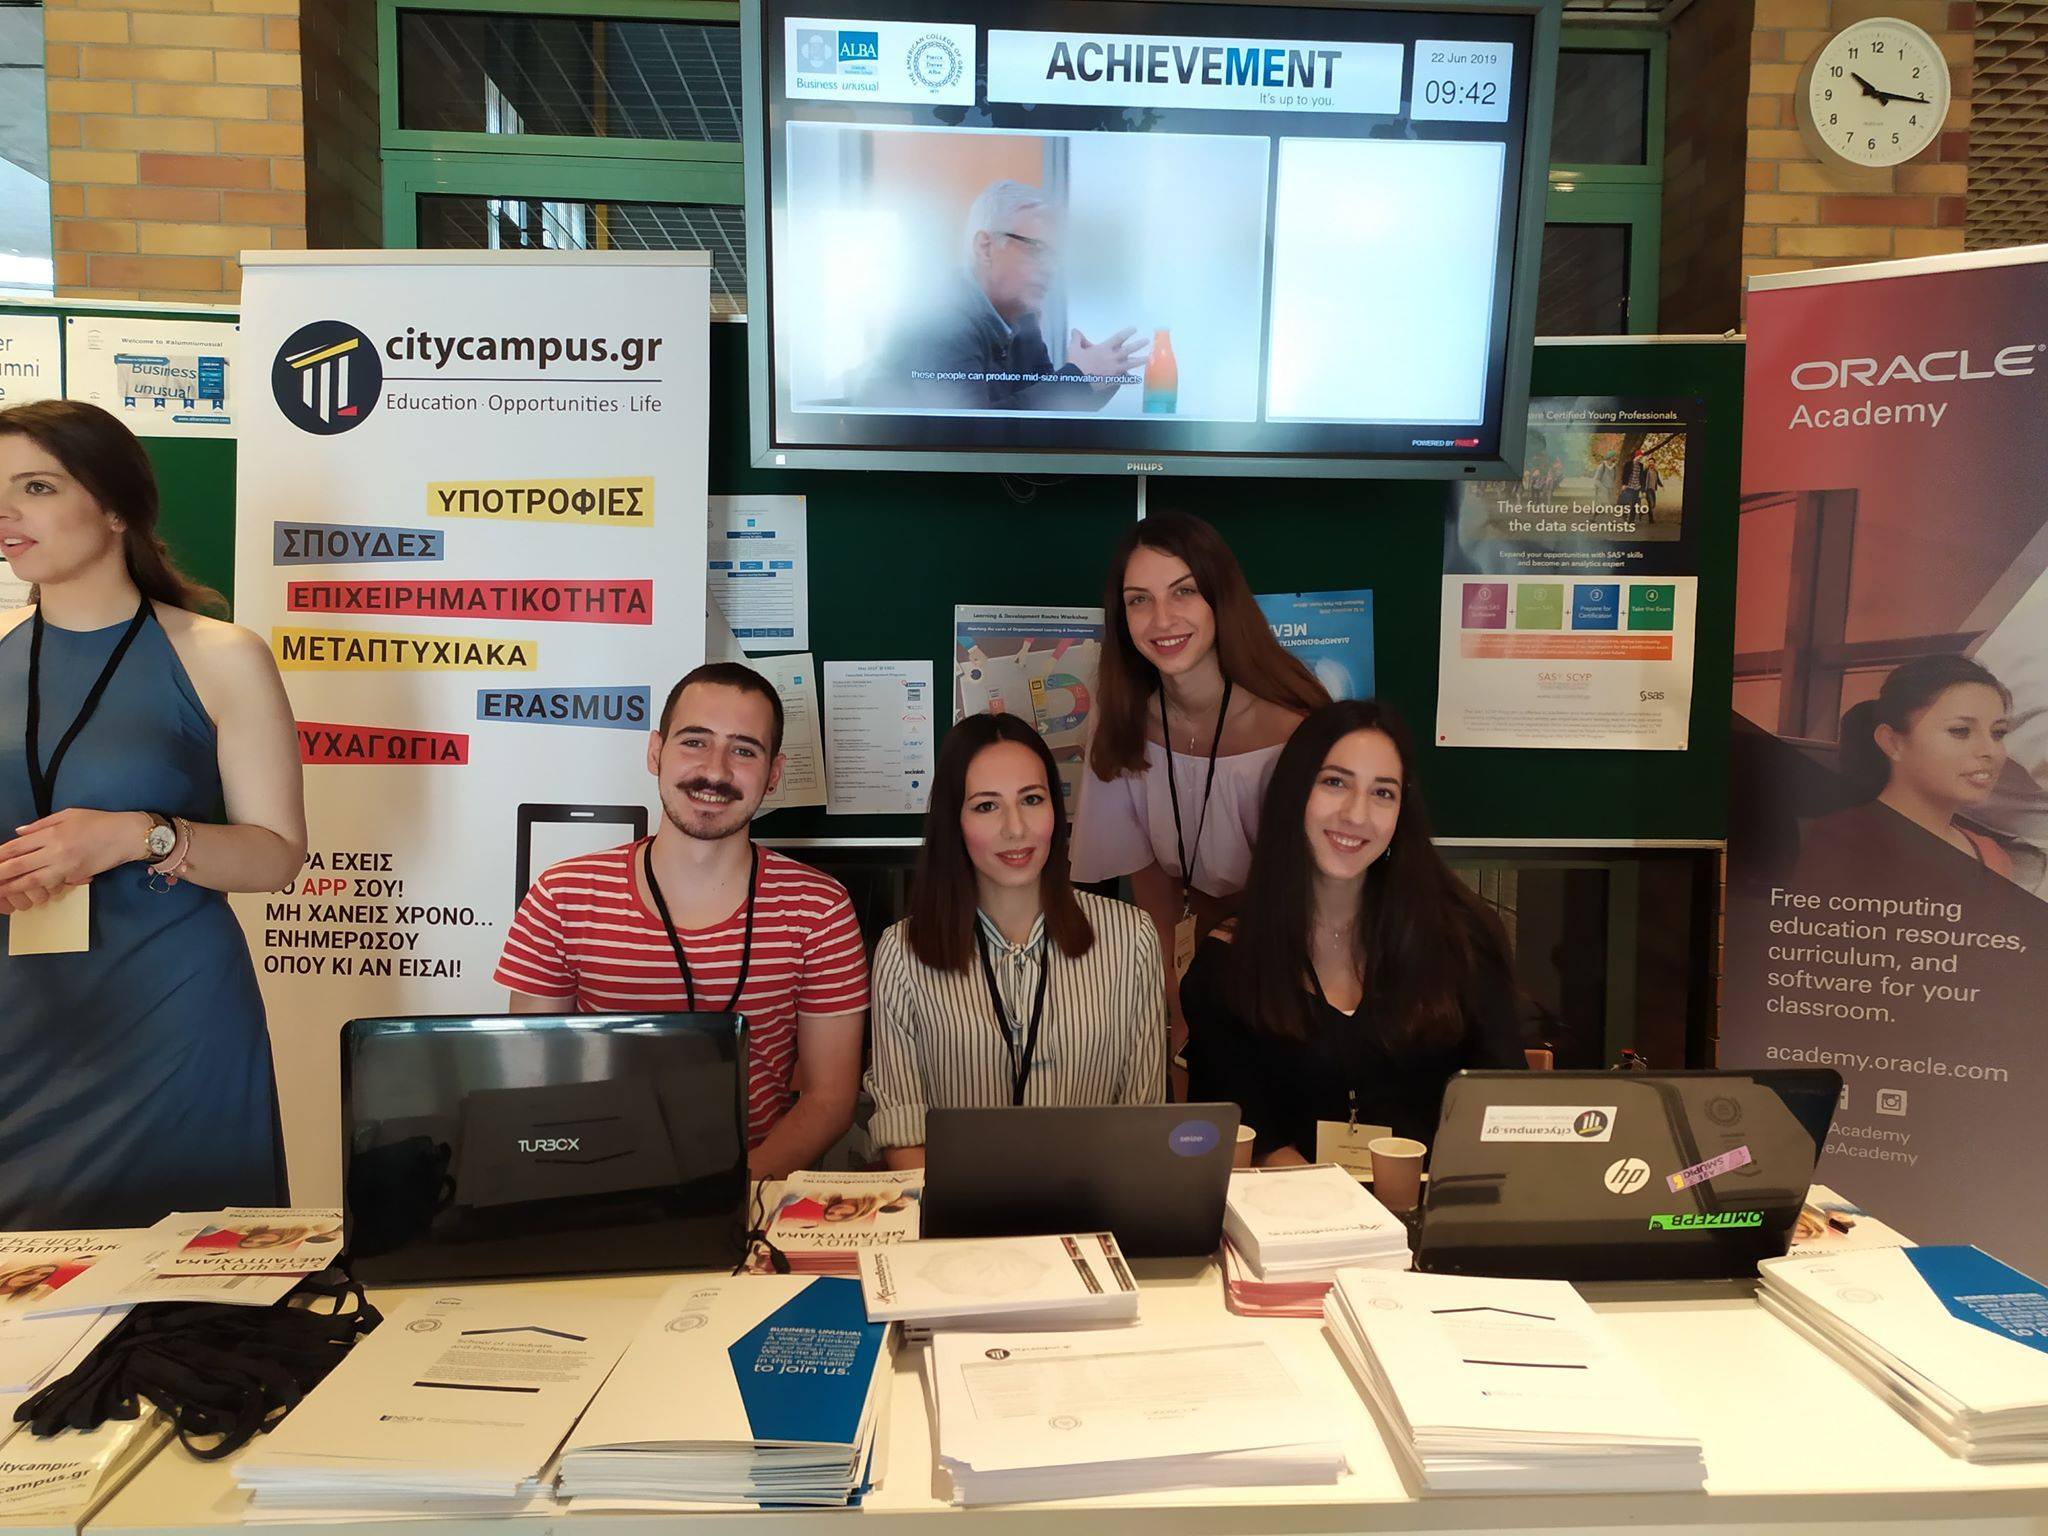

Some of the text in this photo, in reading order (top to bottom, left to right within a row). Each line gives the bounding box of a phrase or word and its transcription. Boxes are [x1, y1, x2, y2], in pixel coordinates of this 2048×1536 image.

[839, 41, 877, 58] ALBA
[1848, 47, 1859, 59] 11
[1871, 42, 1884, 53] 12
[1898, 49, 1904, 60] 1
[1046, 41, 1342, 89] ACHIEVEMENT
[1431, 52, 1497, 65] 22 Jun 2019
[1830, 66, 1843, 77] 10
[1912, 67, 1920, 79] 2
[796, 78, 879, 92] Business unusual
[1424, 80, 1497, 105] 09:42
[1260, 92, 1335, 109] It's up to you.
[1824, 89, 1833, 100] 9
[1917, 92, 1925, 101] 3
[1829, 113, 1838, 125] 8
[1908, 115, 1917, 126] 4
[1846, 132, 1854, 143] 7
[1868, 138, 1876, 150] 6
[1891, 133, 1899, 144] 5
[386, 327, 662, 370] citycampus.gr
[132, 362, 197, 379] Business
[911, 370, 936, 379] these
[937, 371, 966, 382] people
[986, 372, 1021, 383] produce
[1022, 372, 1058, 382] mid-size
[1060, 373, 1103, 383] innovation
[1105, 375, 1143, 385] products
[134, 384, 191, 399] unusual
[387, 393, 662, 415] Education Opportunities Life
[1546, 410, 1586, 420] Certified
[1588, 411, 1617, 422] Young
[1618, 411, 1678, 421] Professionals
[1788, 400, 1948, 430] Academy
[1412, 439, 1445, 447] POWERED
[1127, 462, 1163, 472] PHILIPS
[437, 487, 644, 517] ΥΠΟΤΡΟΦΙΕΣ
[1497, 501, 1649, 518] The future belongs to
[1509, 520, 1636, 533] the data scientists
[283, 529, 437, 558] ΣΠΟΥΔΕΣ
[1500, 551, 1525, 559] Expand
[1543, 551, 1589, 559] opportunities
[1626, 551, 1644, 559] skills
[1532, 559, 1560, 567] become
[1571, 560, 1601, 569] analytics
[1602, 560, 1625, 569] expert
[293, 587, 647, 614] ΕΠΙΧΕΙΡΗΜΑΤΙΚΟΤΗΤΑ
[1269, 623, 1307, 637] ΜΕΛ
[282, 635, 528, 666] ΜΕΤΑΠΤΥΧΙΑΚΑ
[1647, 691, 1664, 700] sas
[484, 694, 645, 722] ERASMUS
[298, 731, 461, 761] ΥΧΑΓΩΓΙΑ
[332, 853, 393, 872] ΕΧΕΙΣ
[302, 879, 403, 898] APP ΣΟΥ!
[1770, 887, 1962, 922] Free computing
[266, 904, 493, 927] ΜΗ ΧΑΝΕΙΣ ΧΡΟΝΟ...
[265, 930, 419, 951] ΕΝΗΜΕΡΩΣΟΥ
[1769, 916, 2027, 953] education resources,
[1768, 944, 1957, 973] curriculum, and
[264, 956, 461, 978] ΟΠΟΥ ΚΙ ΑΝ ΕΙΣΑΙ!
[1767, 970, 1980, 1003] software for your
[1767, 996, 1896, 1023] classroom.
[1766, 1045, 2008, 1082] academy.oracle.com
[1486, 1126, 1572, 1136] citycampus.gr
[1609, 1158, 1646, 1193] hp
[776, 1230, 906, 1240] ΜΕΤΑΠΤΥΧΙΑΚΑ
[175, 1256, 327, 1265] ΜΕΤΑΠΤΥΧΙΑΚΑ
[817, 1329, 862, 1337] UNUSUAL
[754, 1363, 850, 1375] to join us.
[796, 1359, 853, 1368] mentality
